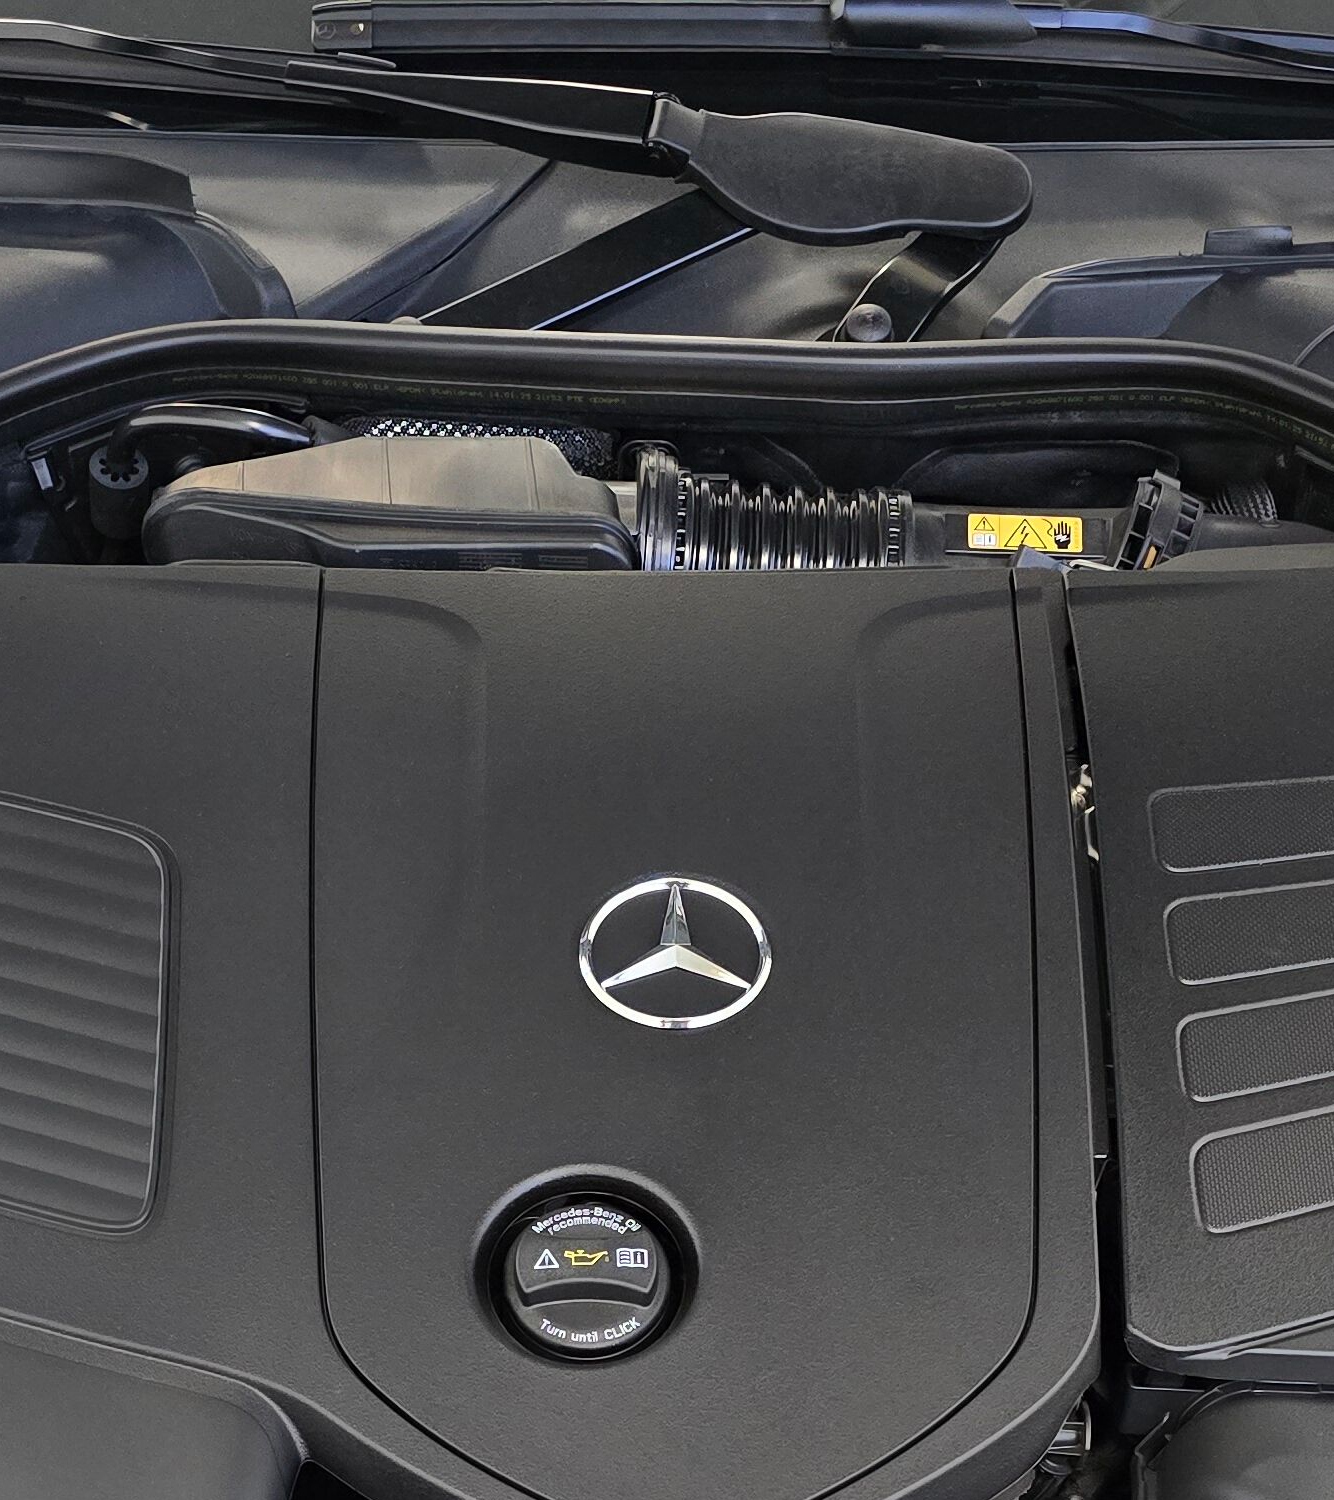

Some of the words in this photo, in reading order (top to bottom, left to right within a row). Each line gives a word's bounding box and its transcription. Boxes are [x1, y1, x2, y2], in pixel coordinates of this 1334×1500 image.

[531, 1206, 624, 1234] Mercedes-Benz
[625, 1218, 642, 1232] Oil
[547, 1216, 628, 1236] recommended
[540, 1318, 566, 1339] Turn
[570, 1331, 598, 1343] until
[604, 1316, 641, 1340] CLICK
